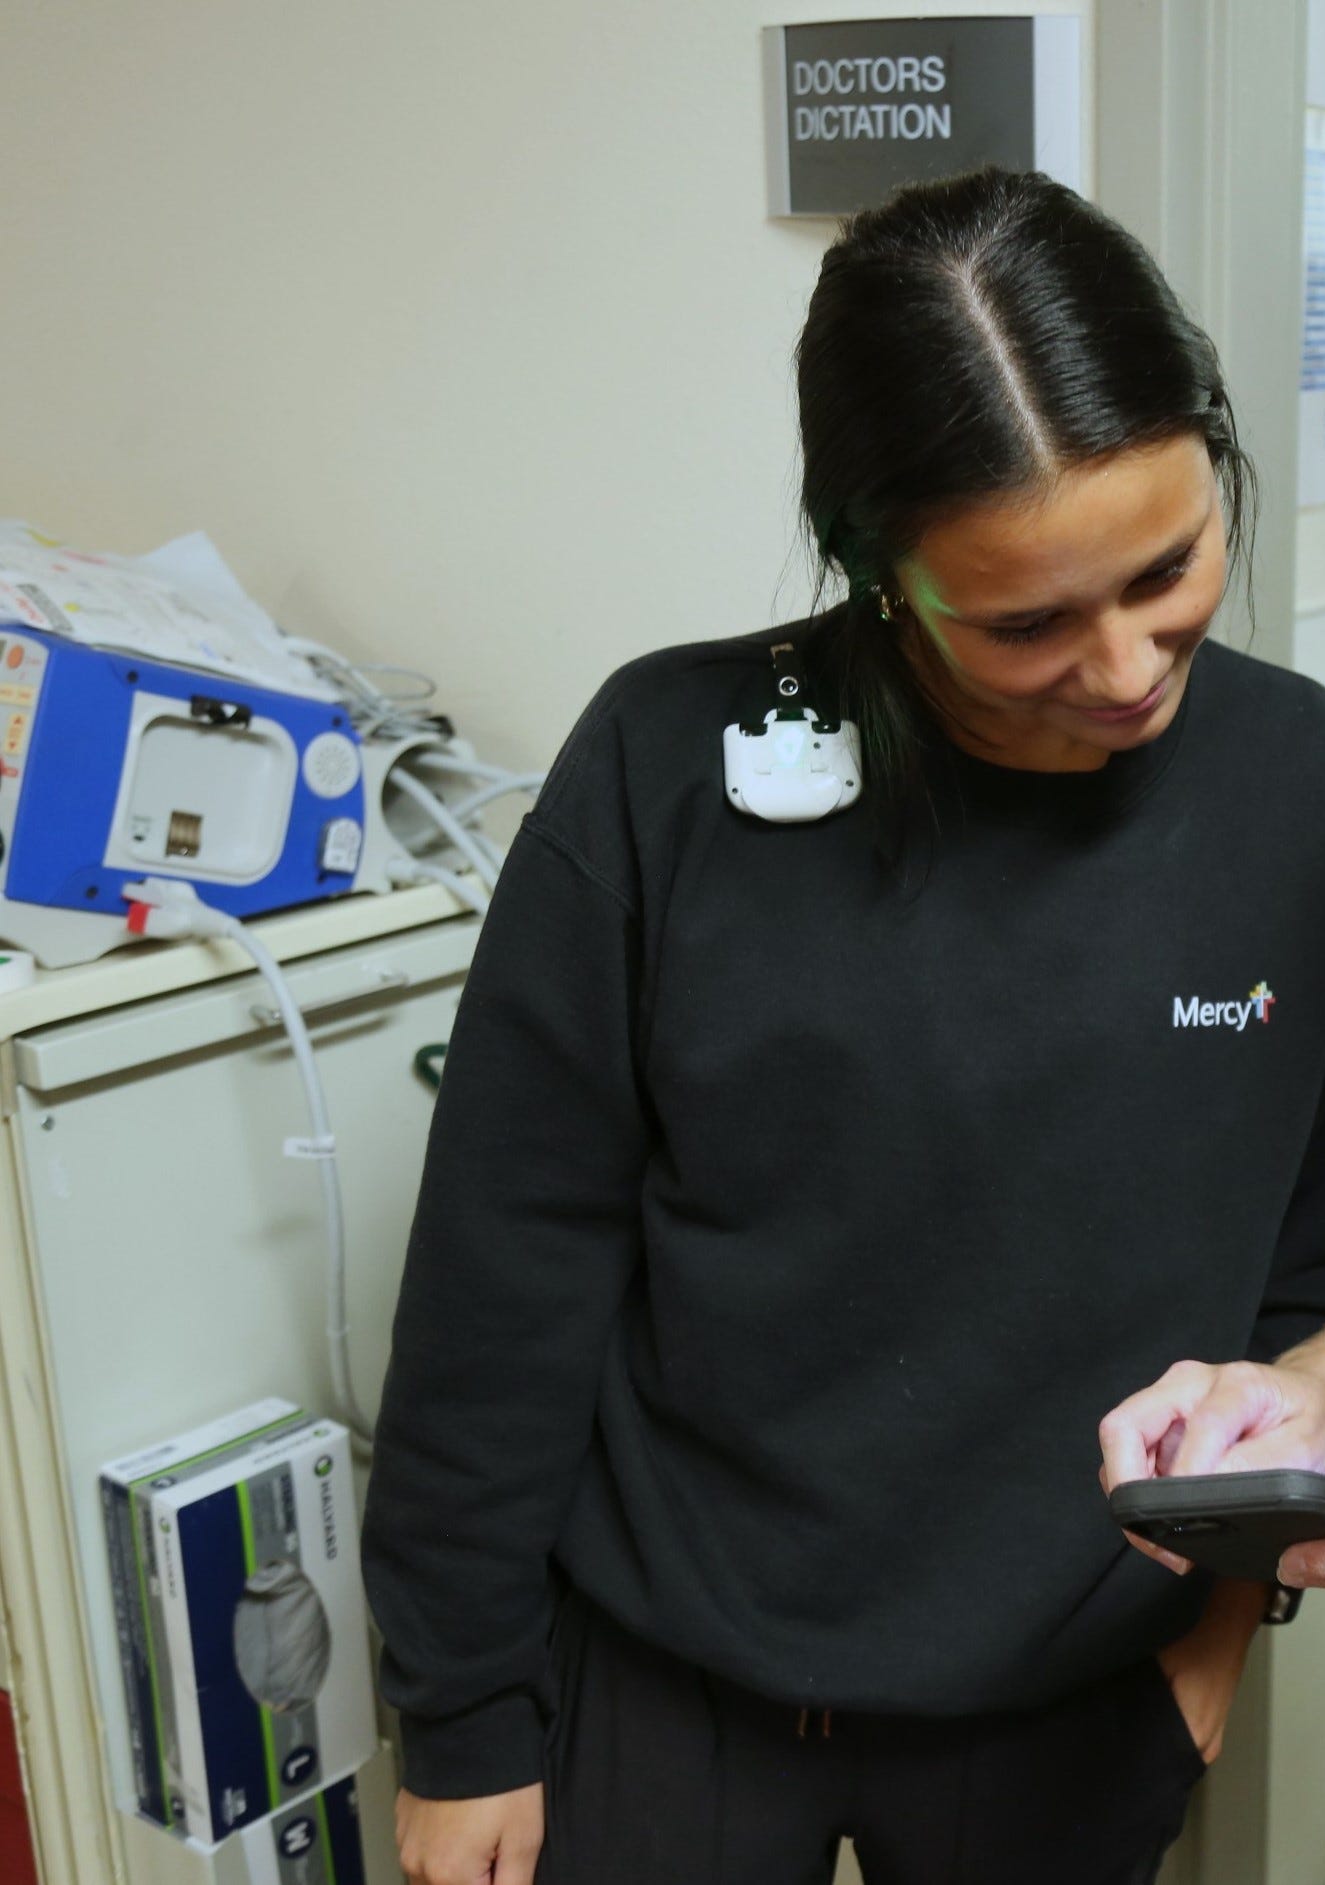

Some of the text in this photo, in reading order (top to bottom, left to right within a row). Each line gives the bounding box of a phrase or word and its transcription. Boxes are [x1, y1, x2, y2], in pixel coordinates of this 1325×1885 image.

[794, 56, 945, 95] DOCTORS
[795, 103, 951, 140] DICTATION
[1173, 996, 1252, 1031] Mercy
[321, 1481, 338, 1560] HALYARD
